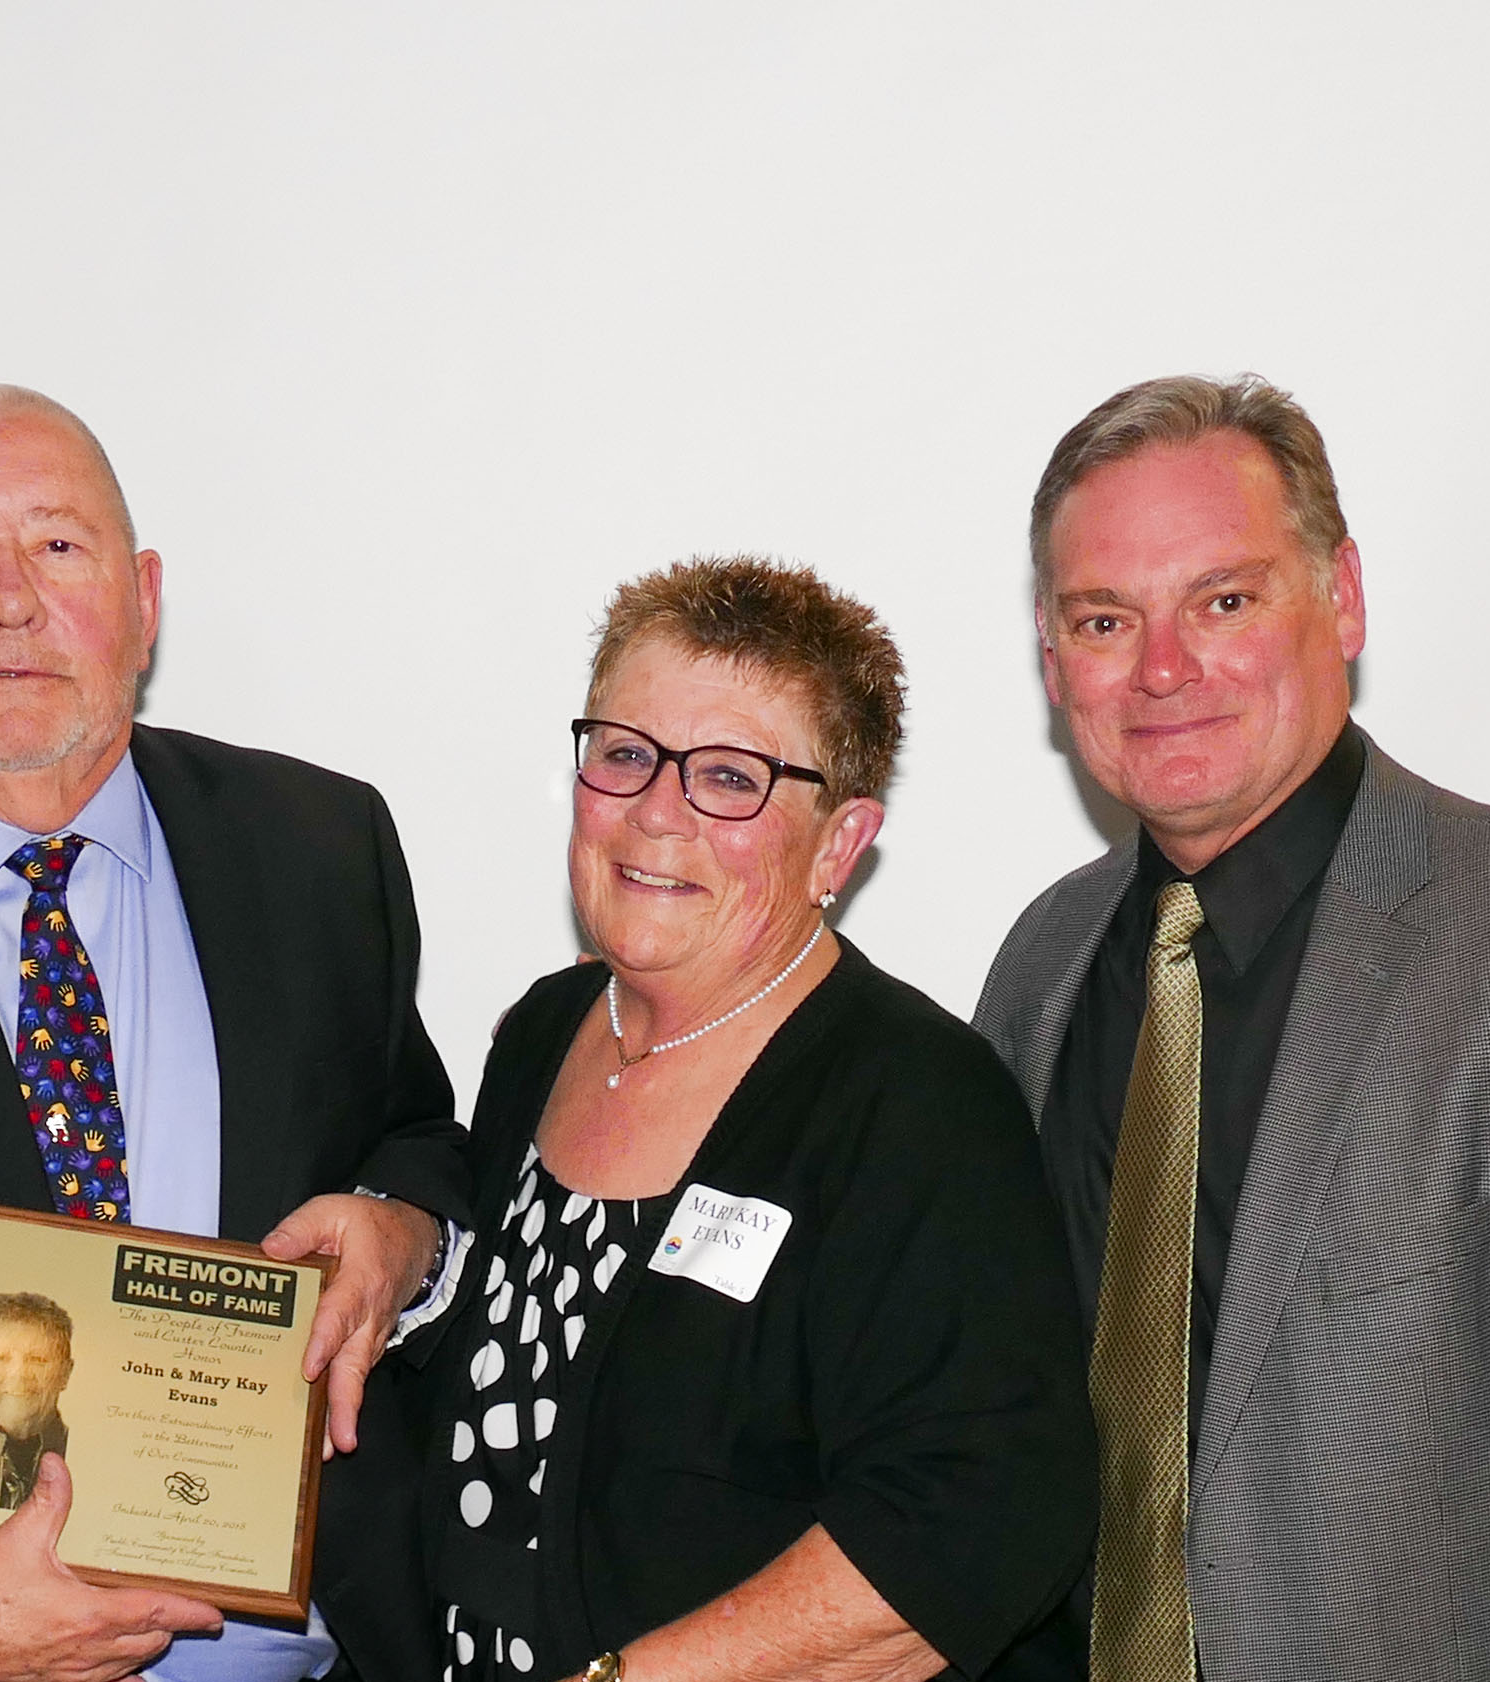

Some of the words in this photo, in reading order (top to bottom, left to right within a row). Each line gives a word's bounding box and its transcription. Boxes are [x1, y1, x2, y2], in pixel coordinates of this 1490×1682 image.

[735, 1208, 777, 1232] KAY
[124, 1251, 291, 1293] FREMONT
[127, 1280, 182, 1302] HALL
[189, 1290, 218, 1306] OF
[224, 1295, 281, 1316] FAME
[119, 1306, 147, 1323] The
[152, 1313, 203, 1333] People
[207, 1322, 221, 1339] of
[225, 1324, 282, 1343] Fremont
[134, 1328, 159, 1340] and
[161, 1330, 204, 1347] Custer
[209, 1337, 263, 1355] Counties
[173, 1347, 221, 1364] Honor
[122, 1361, 164, 1377] John
[171, 1368, 183, 1379] &
[189, 1370, 230, 1389] Mary
[236, 1377, 268, 1394] Kay
[168, 1389, 218, 1407] Evans
[235, 1425, 273, 1439] Efforts
[163, 1512, 201, 1524] April
